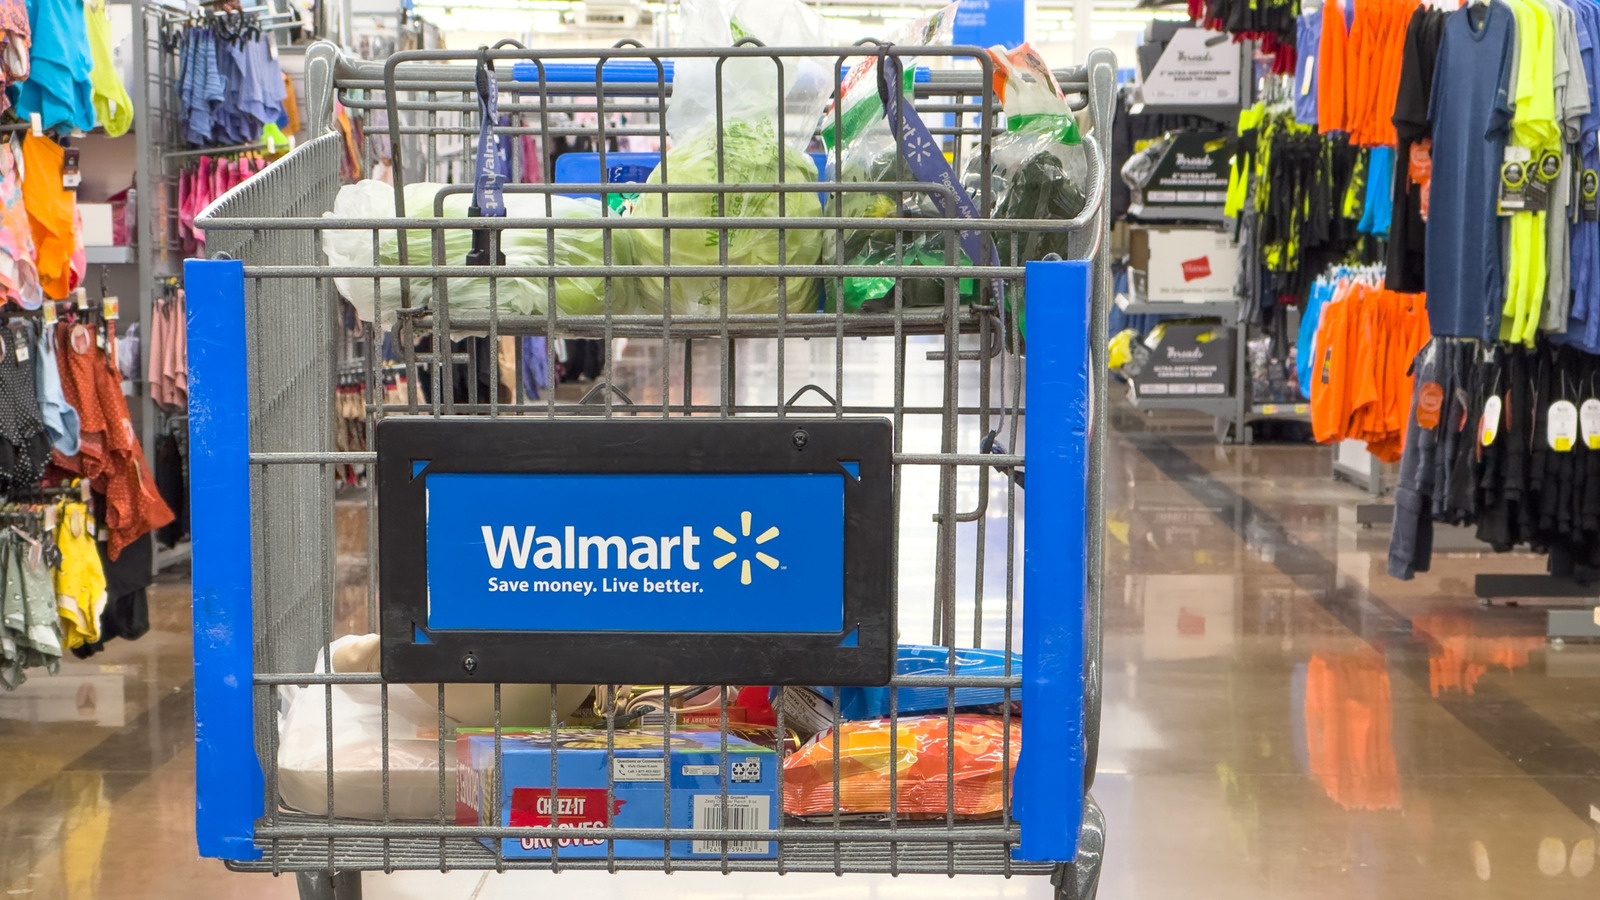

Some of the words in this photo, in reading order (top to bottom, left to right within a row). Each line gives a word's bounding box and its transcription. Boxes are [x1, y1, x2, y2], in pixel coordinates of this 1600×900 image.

[481, 525, 700, 570] Walmart
[488, 577, 529, 593] Save
[533, 580, 598, 596] money.
[602, 577, 639, 593] Live
[643, 577, 704, 593] better.
[536, 797, 586, 815] CHEZ-IT
